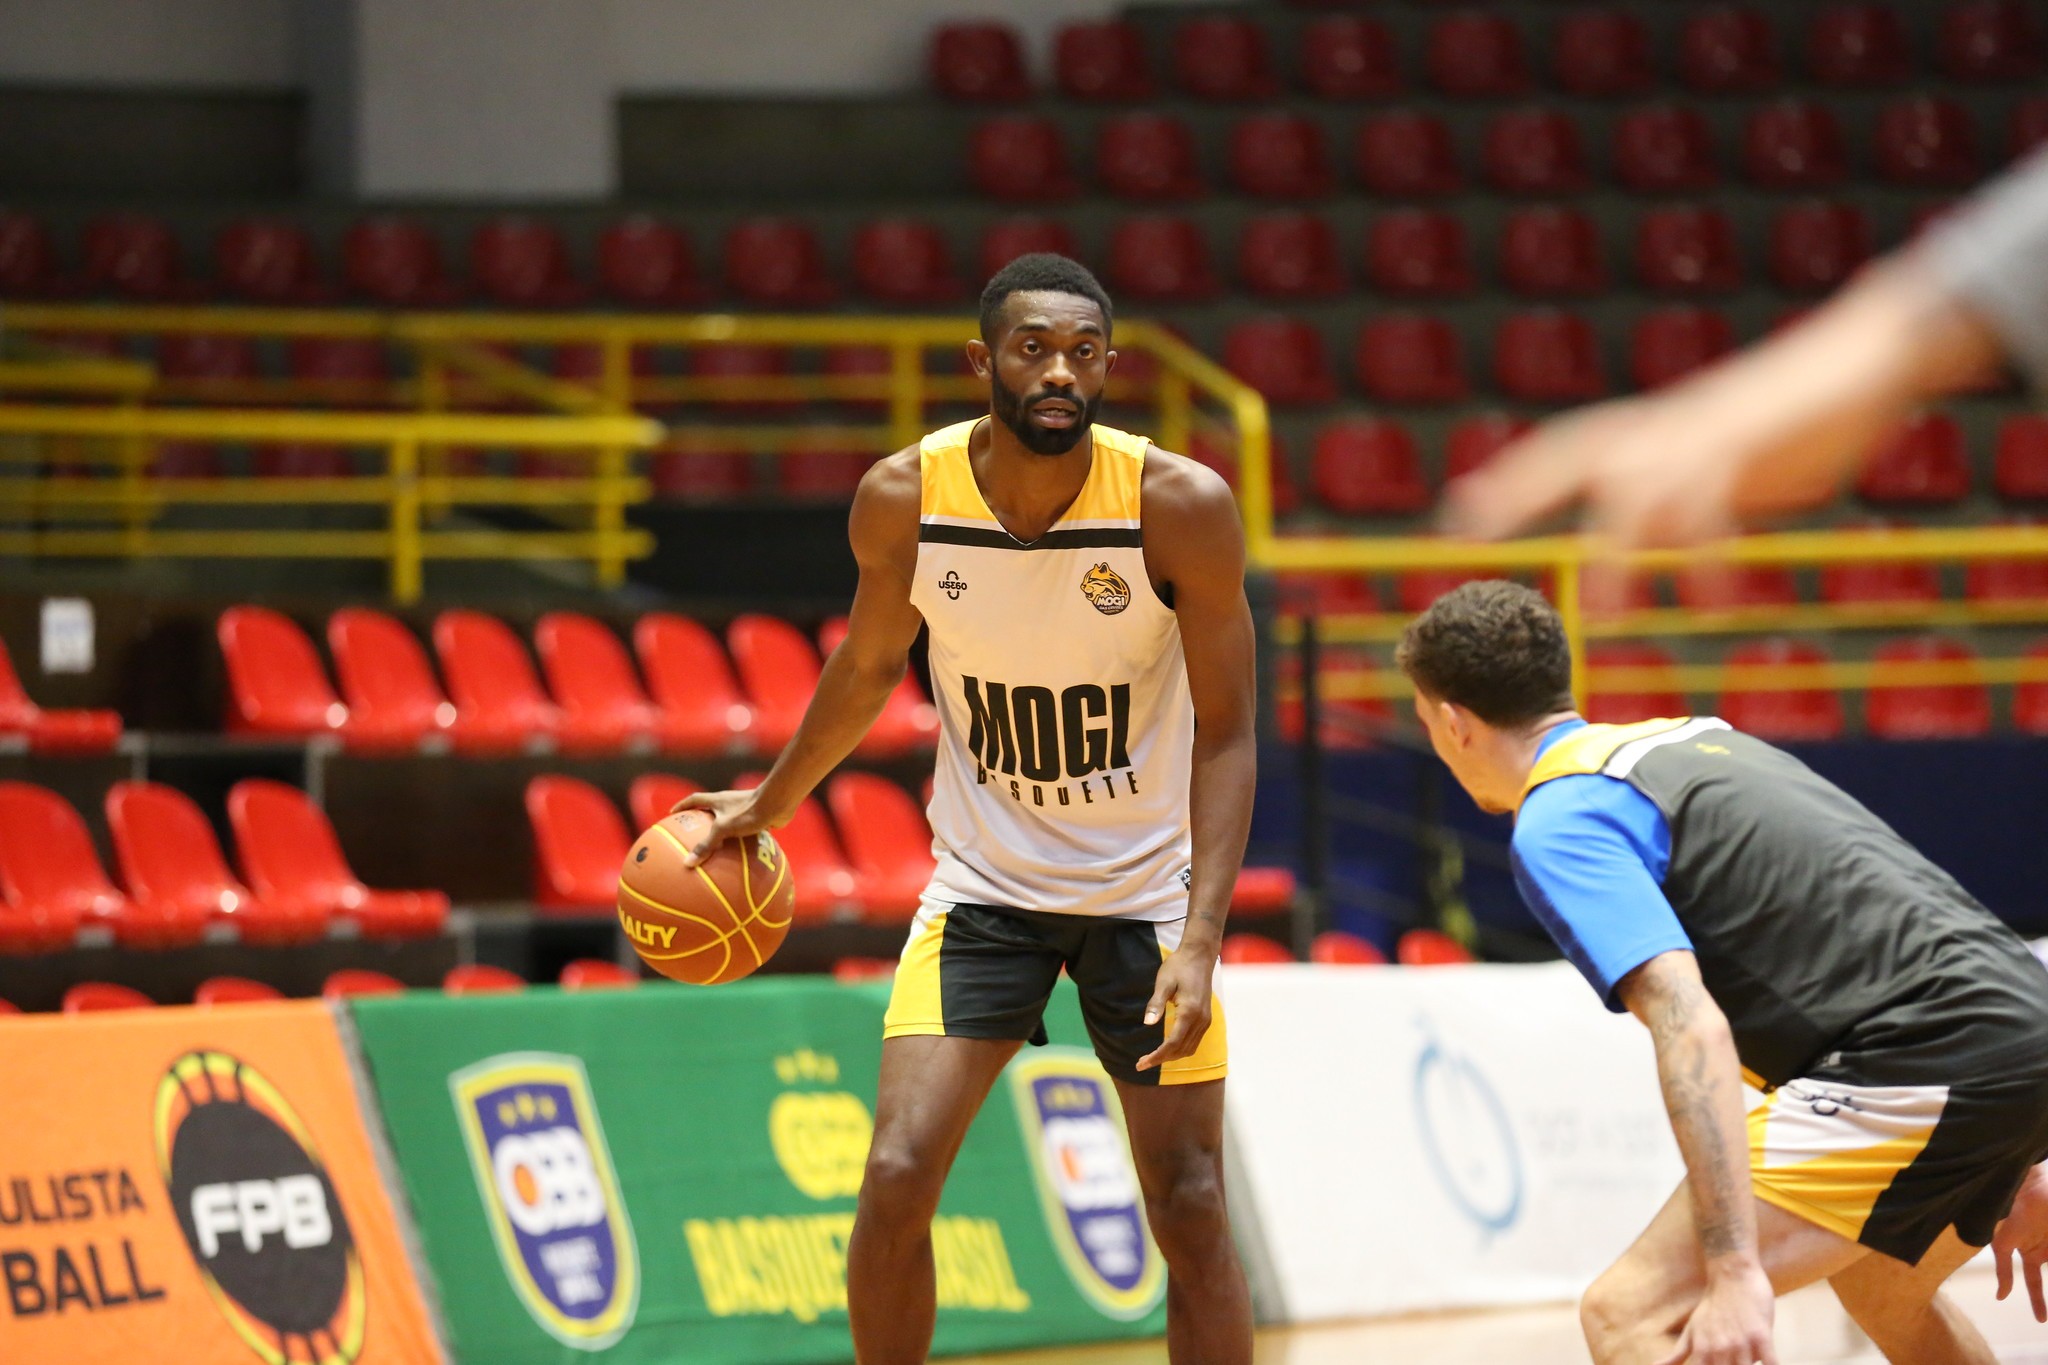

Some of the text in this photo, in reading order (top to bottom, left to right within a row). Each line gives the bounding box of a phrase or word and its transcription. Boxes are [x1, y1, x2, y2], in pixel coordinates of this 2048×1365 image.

[1096, 595, 1125, 607] MOGI
[961, 673, 1131, 782] MOGI
[977, 761, 1139, 807] BSQUETE
[0, 1167, 146, 1225] ULISTA
[191, 1173, 333, 1259] FPB
[1, 1238, 165, 1317] BALL
